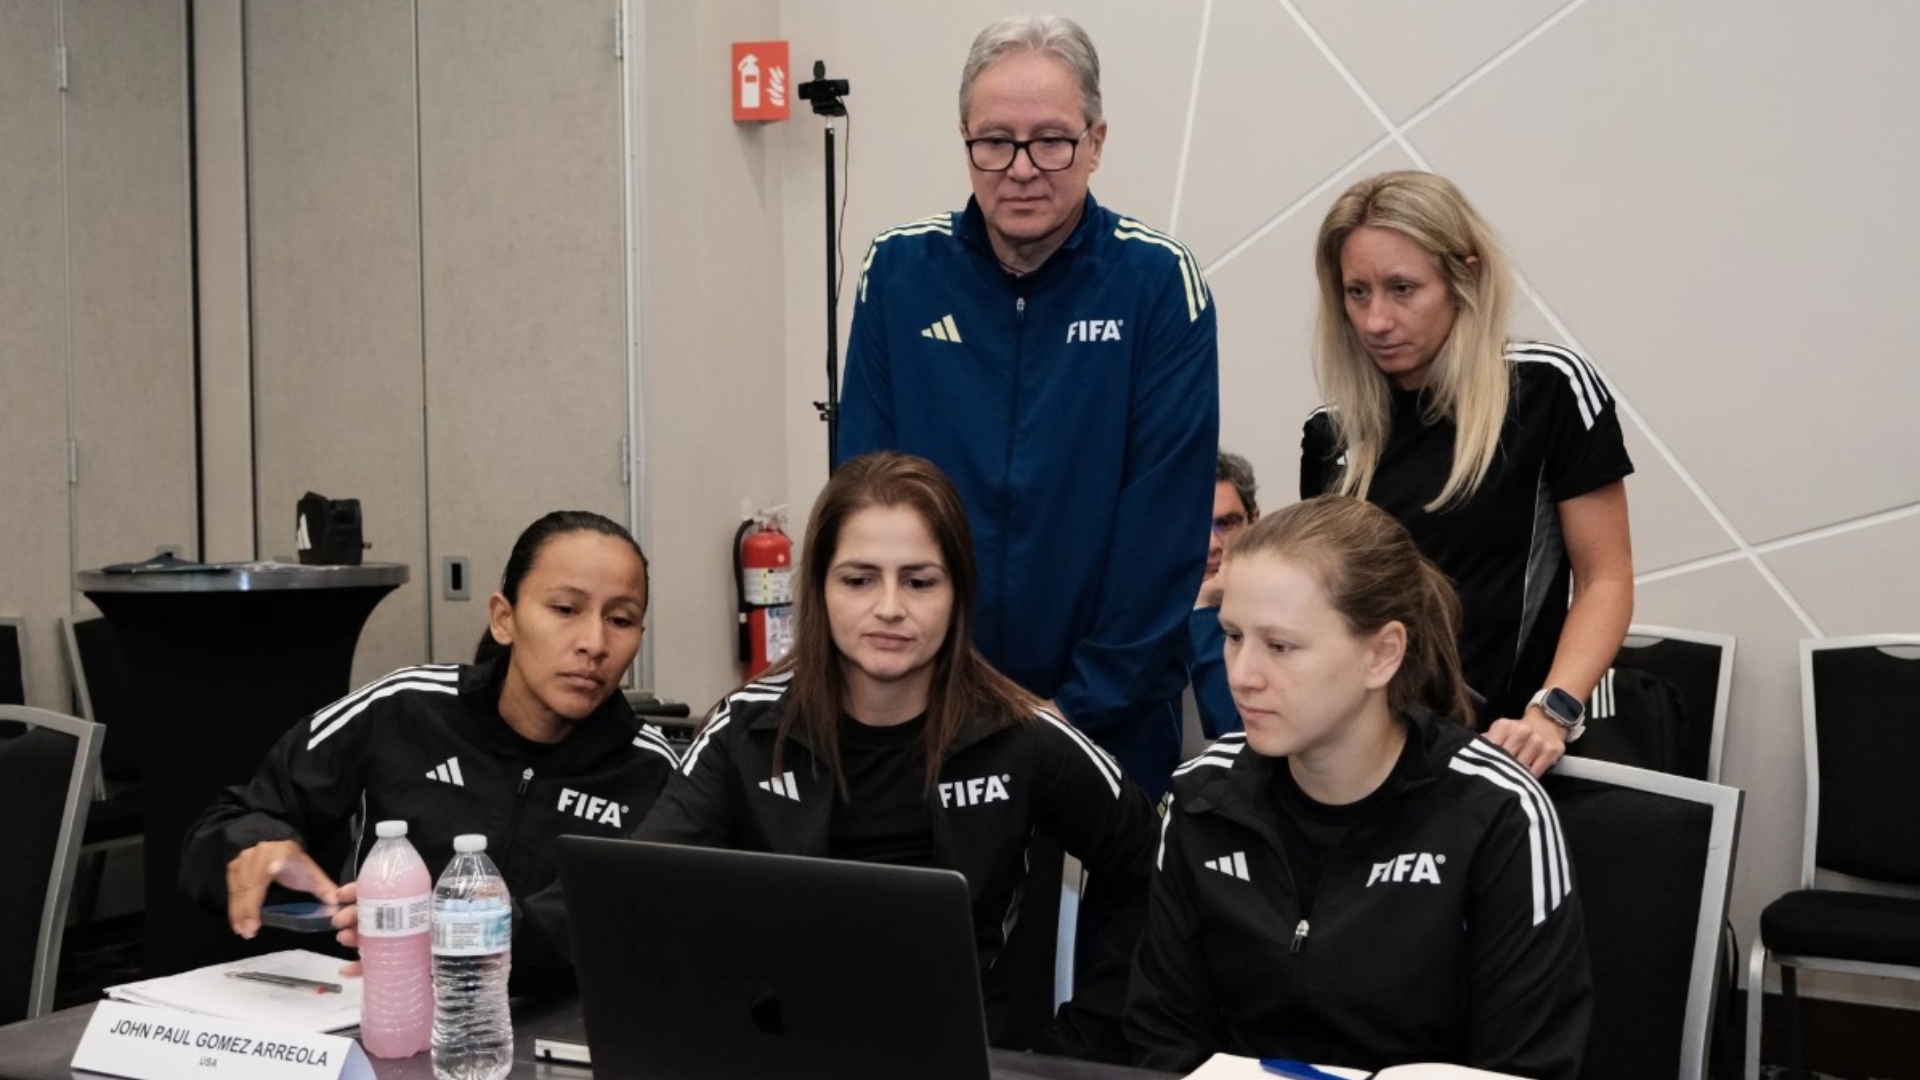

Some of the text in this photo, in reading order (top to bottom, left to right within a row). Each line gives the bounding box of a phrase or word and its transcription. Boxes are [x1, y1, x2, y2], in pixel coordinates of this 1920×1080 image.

[1066, 320, 1121, 343] FIFA
[557, 787, 622, 828] FIFA
[938, 775, 1009, 808] FIFA
[1366, 852, 1441, 887] FIFA
[110, 1019, 328, 1067] JOHN PAUL GOMEZ ARREOLA
[199, 1057, 218, 1067] USA
